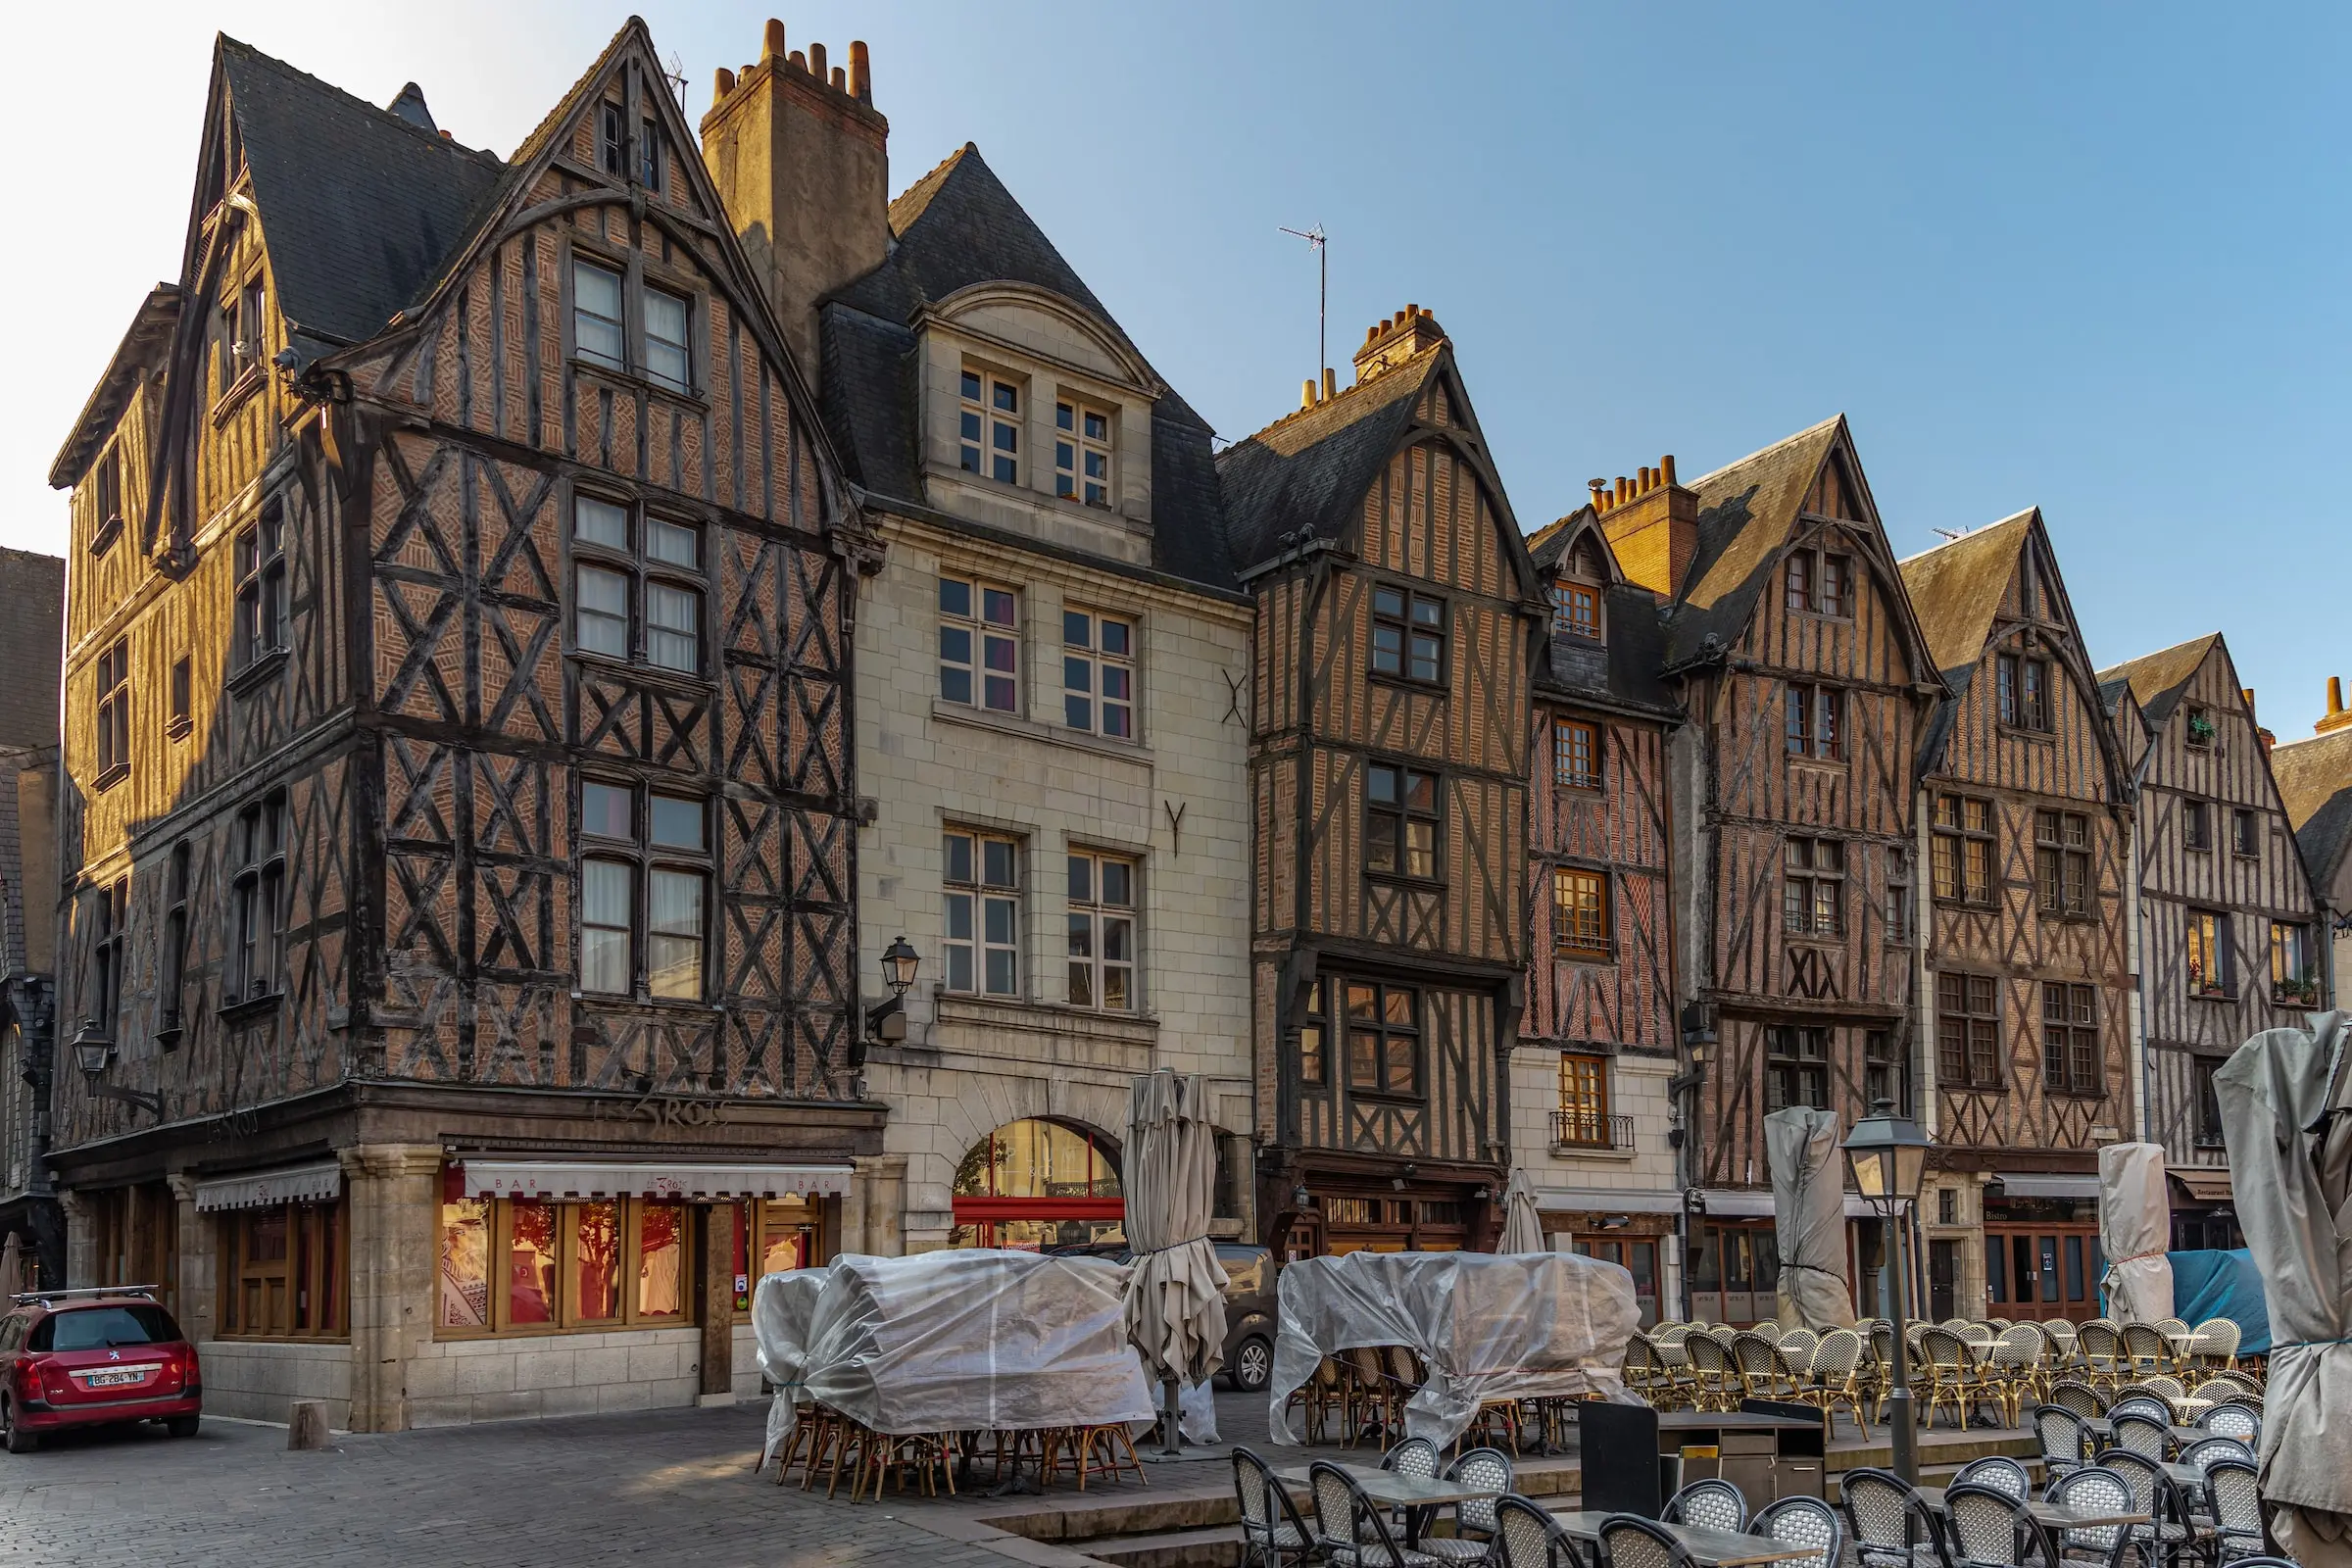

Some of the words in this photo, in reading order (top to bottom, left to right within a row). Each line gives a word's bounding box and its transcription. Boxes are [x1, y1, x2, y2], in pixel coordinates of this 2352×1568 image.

[664, 1097, 730, 1128] ROIS
[495, 1179, 537, 1190] BAR
[656, 1177, 667, 1196] 3
[798, 1180, 831, 1190] BAR
[1985, 1210, 2008, 1221] Bistro
